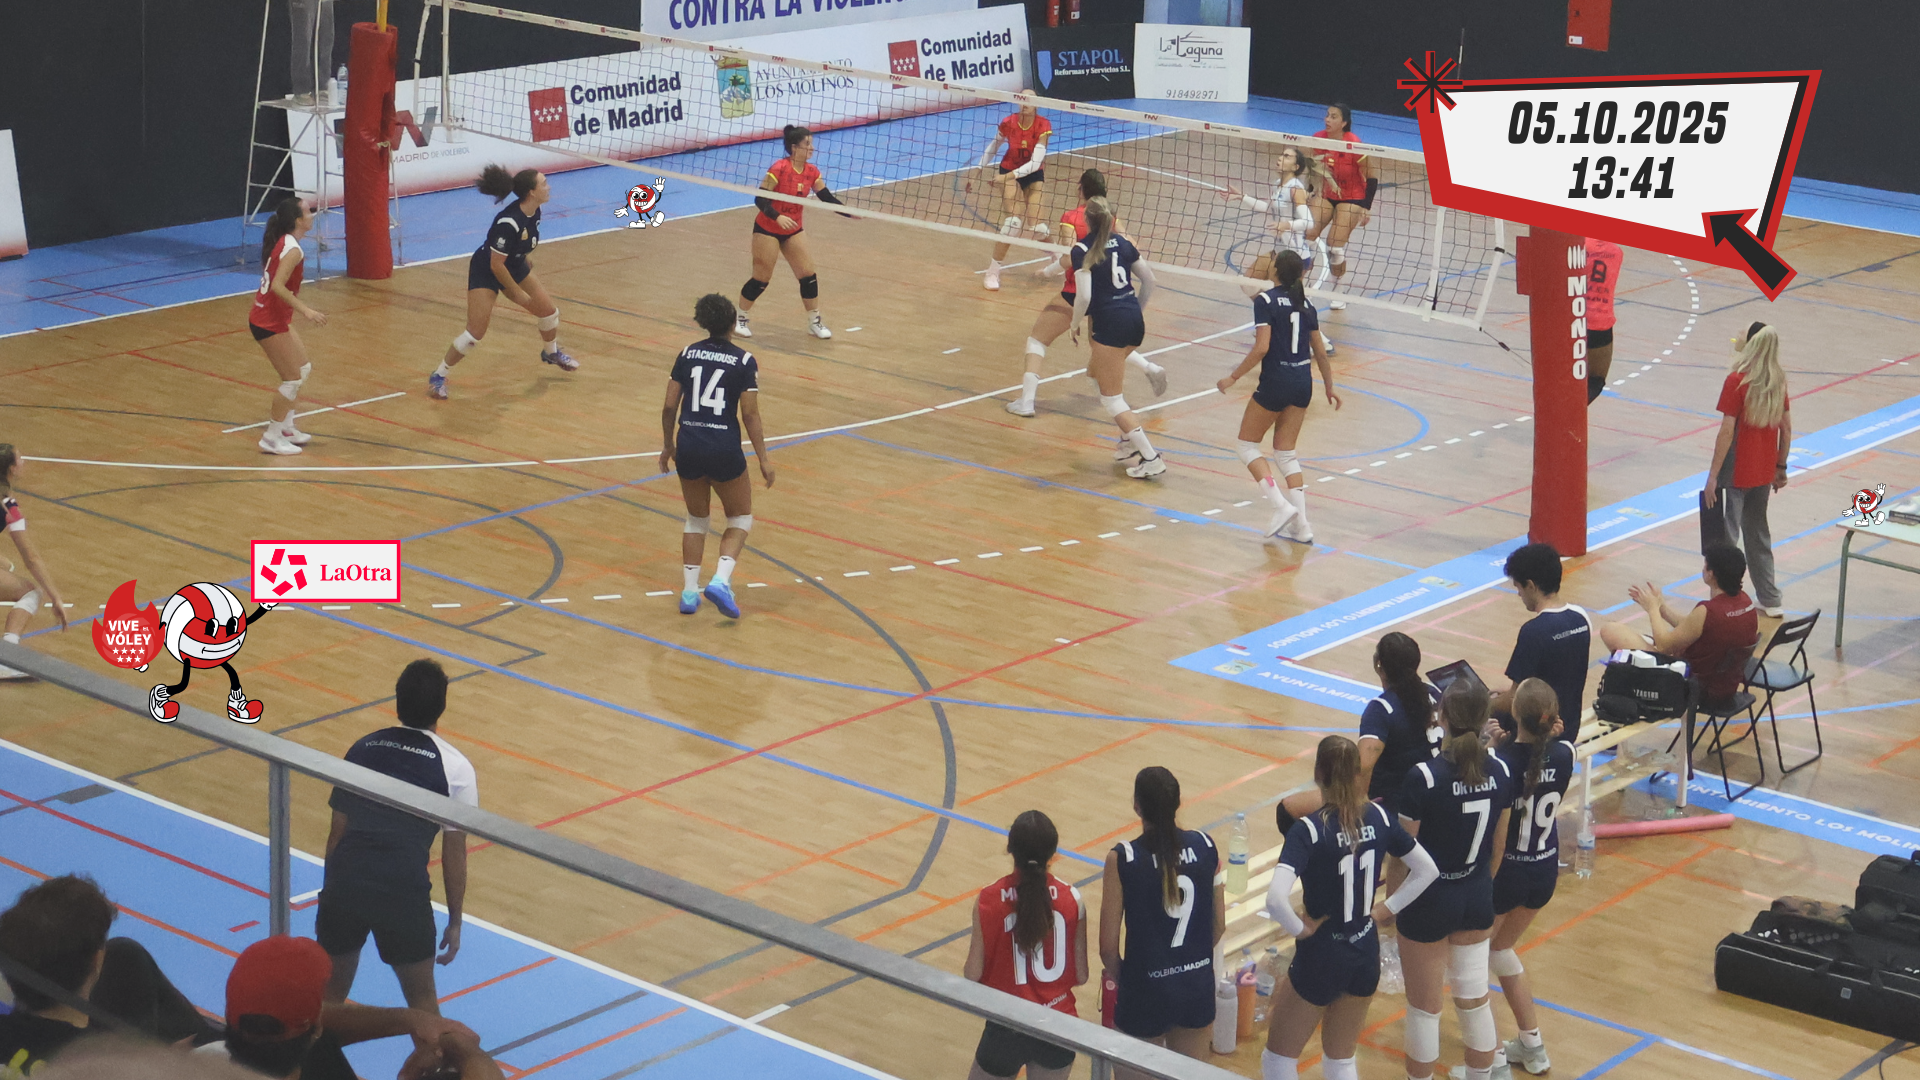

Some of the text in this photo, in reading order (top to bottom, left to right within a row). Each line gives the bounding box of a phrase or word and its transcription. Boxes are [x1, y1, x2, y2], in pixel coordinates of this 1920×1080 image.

[669, 0, 765, 29] CONTRA
[921, 27, 1012, 56] Comunidad
[1176, 35, 1223, 62] Laguna
[924, 53, 1015, 82] de Madrid
[1054, 68, 1085, 76] Reformas
[1090, 66, 1119, 75] Servicios
[1058, 49, 1124, 67] STAPOL
[570, 71, 682, 105] Comunidad
[756, 74, 854, 100] LOS MOLINOS
[1166, 89, 1219, 100] 918492971
[574, 99, 683, 136] de Madrid
[1112, 252, 1128, 289] 6
[1290, 311, 1300, 354] 1
[1567, 275, 1587, 380] MONDO
[686, 349, 739, 366] STACKHOUSE
[690, 365, 726, 416] 14
[1256, 671, 1371, 705] AYUNTAMIEN
[365, 740, 437, 759] VOLEIBOLMADRID
[1462, 798, 1491, 864] 7
[1515, 791, 1561, 852] 19
[1814, 818, 1854, 833] LOS
[1336, 825, 1377, 848] FULER
[1338, 849, 1376, 923] 11
[1164, 874, 1195, 949] 9
[1004, 909, 1067, 986] 10
[1147, 957, 1211, 978] VOLEIBOLMADRID
